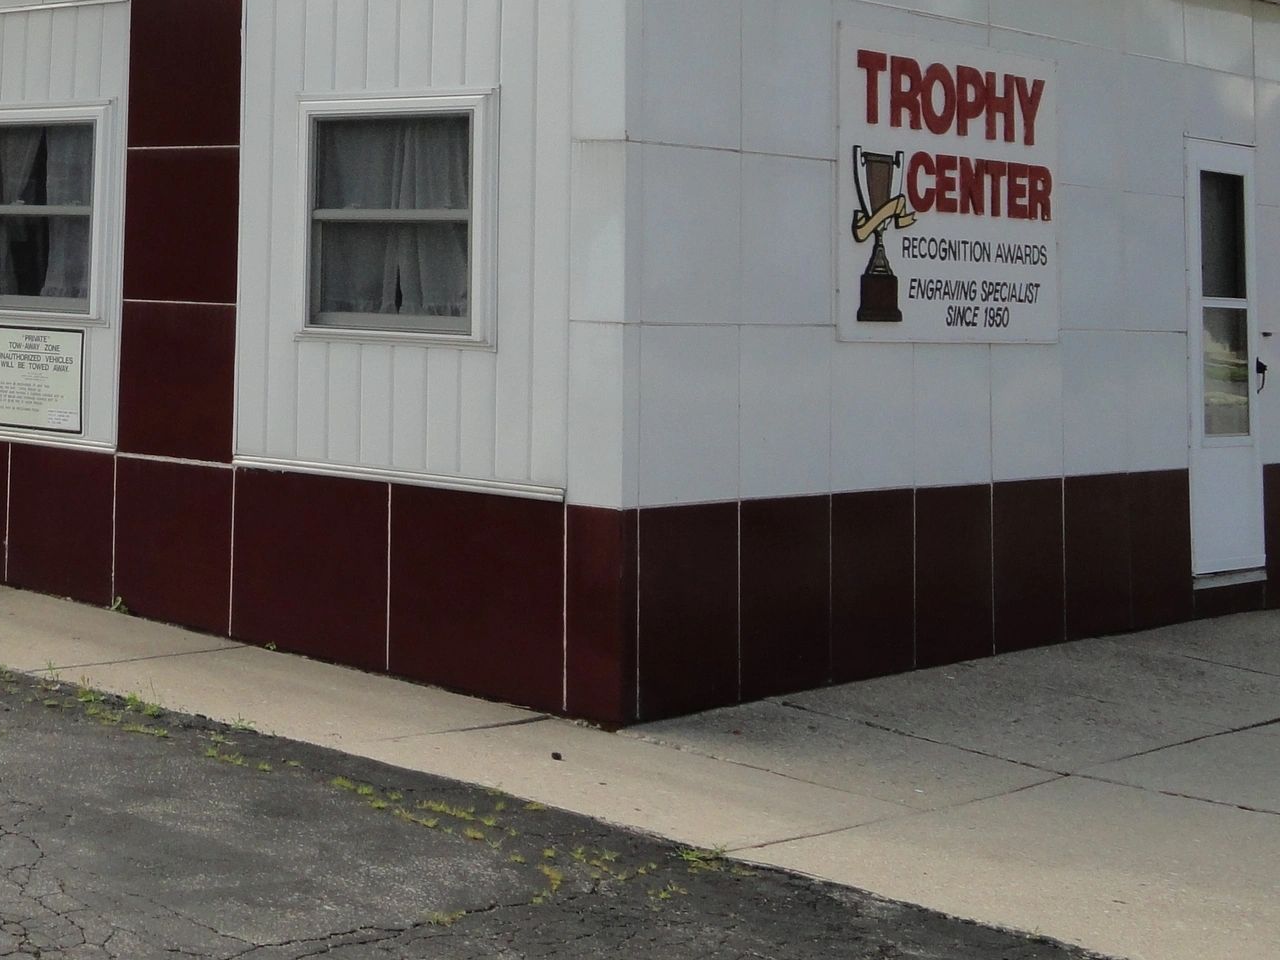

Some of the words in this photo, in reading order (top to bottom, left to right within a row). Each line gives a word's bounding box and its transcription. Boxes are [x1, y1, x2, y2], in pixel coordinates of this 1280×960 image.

[857, 49, 1045, 146] TROPHY
[906, 151, 1052, 221] CENTER
[902, 236, 991, 262] RECOGNITION
[995, 242, 1048, 266] AWARDS
[908, 278, 978, 301] ENGRAVING
[980, 280, 1041, 304] SPECIALIST
[945, 305, 980, 327] SINCE
[983, 306, 1010, 328] 1950
[44, 343, 61, 352] ZONE
[0, 360, 14, 368] WILL
[17, 361, 26, 369] BE
[29, 362, 50, 371] TOWED
[45, 355, 74, 365] VEHICLES
